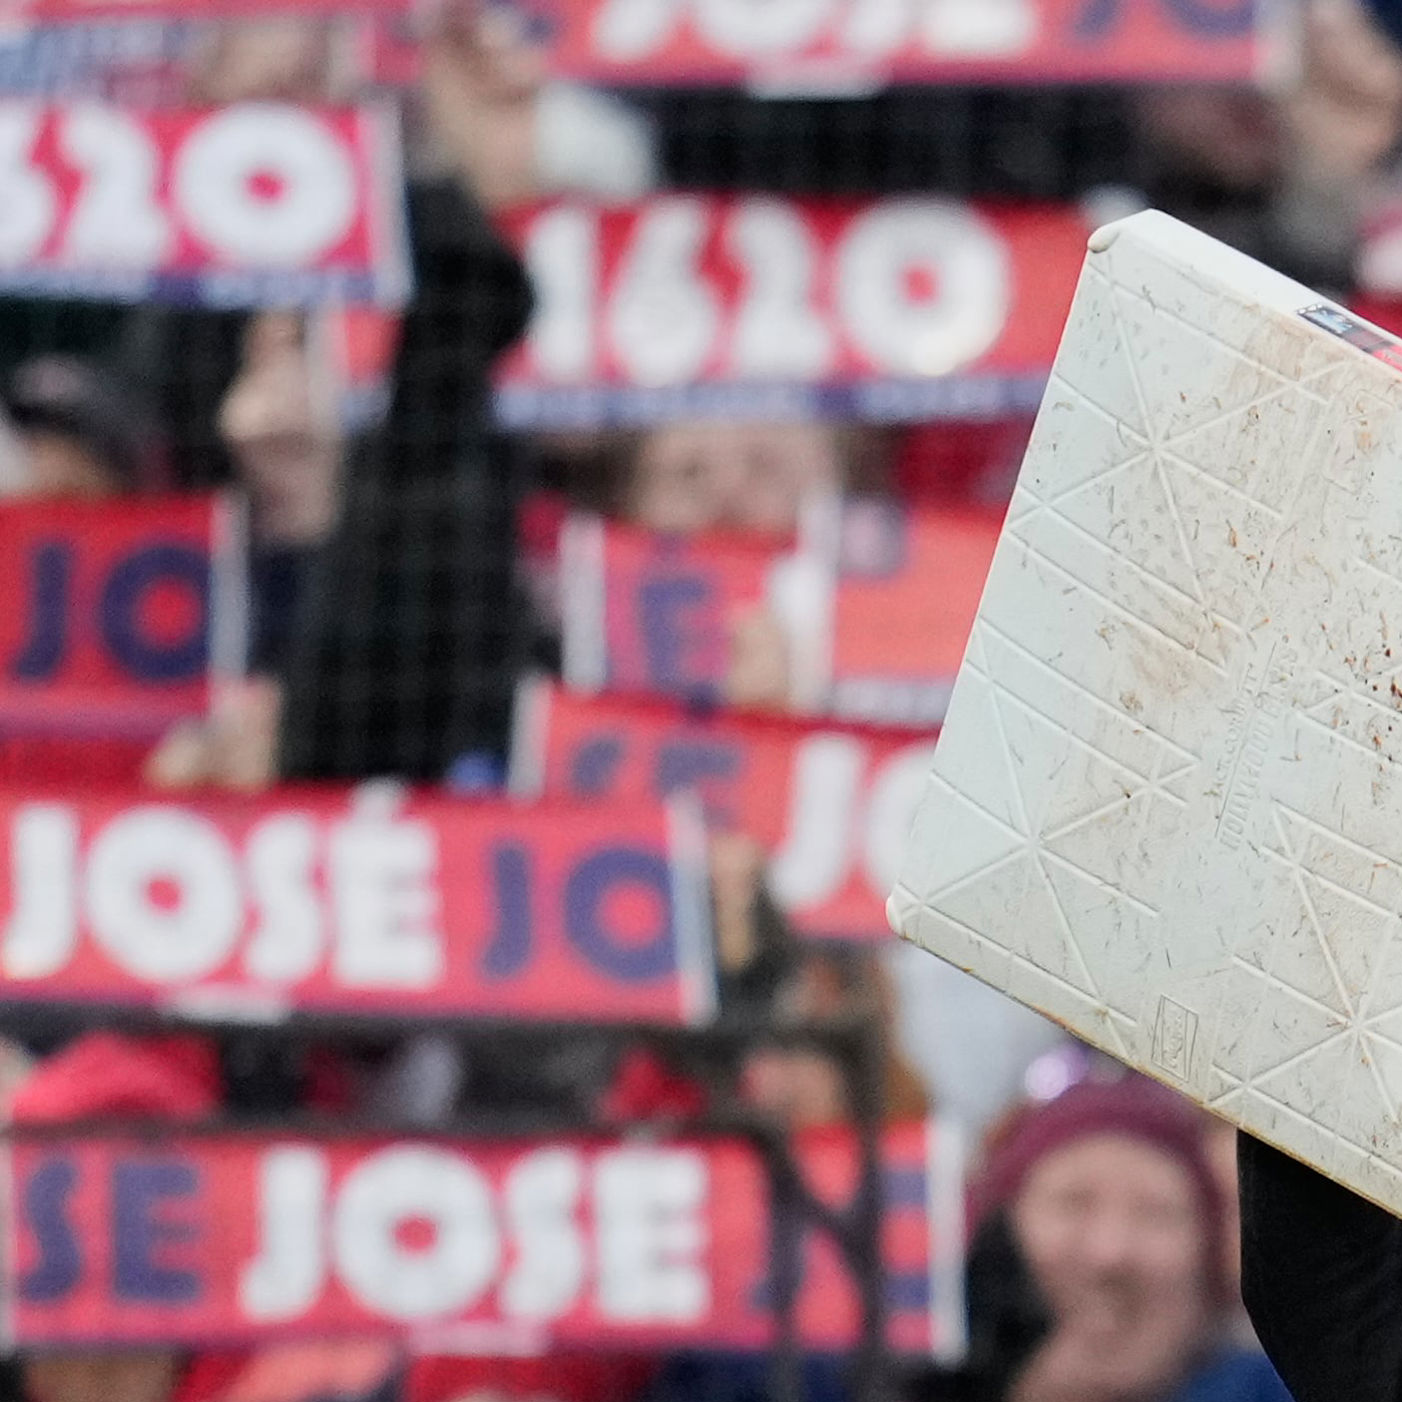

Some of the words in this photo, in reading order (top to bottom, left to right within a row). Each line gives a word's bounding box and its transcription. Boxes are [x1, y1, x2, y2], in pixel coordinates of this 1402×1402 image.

[523, 197, 1007, 384] 1620
[17, 542, 208, 681] JO
[5, 778, 441, 988] JOSÉ
[480, 844, 675, 982] JO
[20, 1158, 199, 1303] SE
